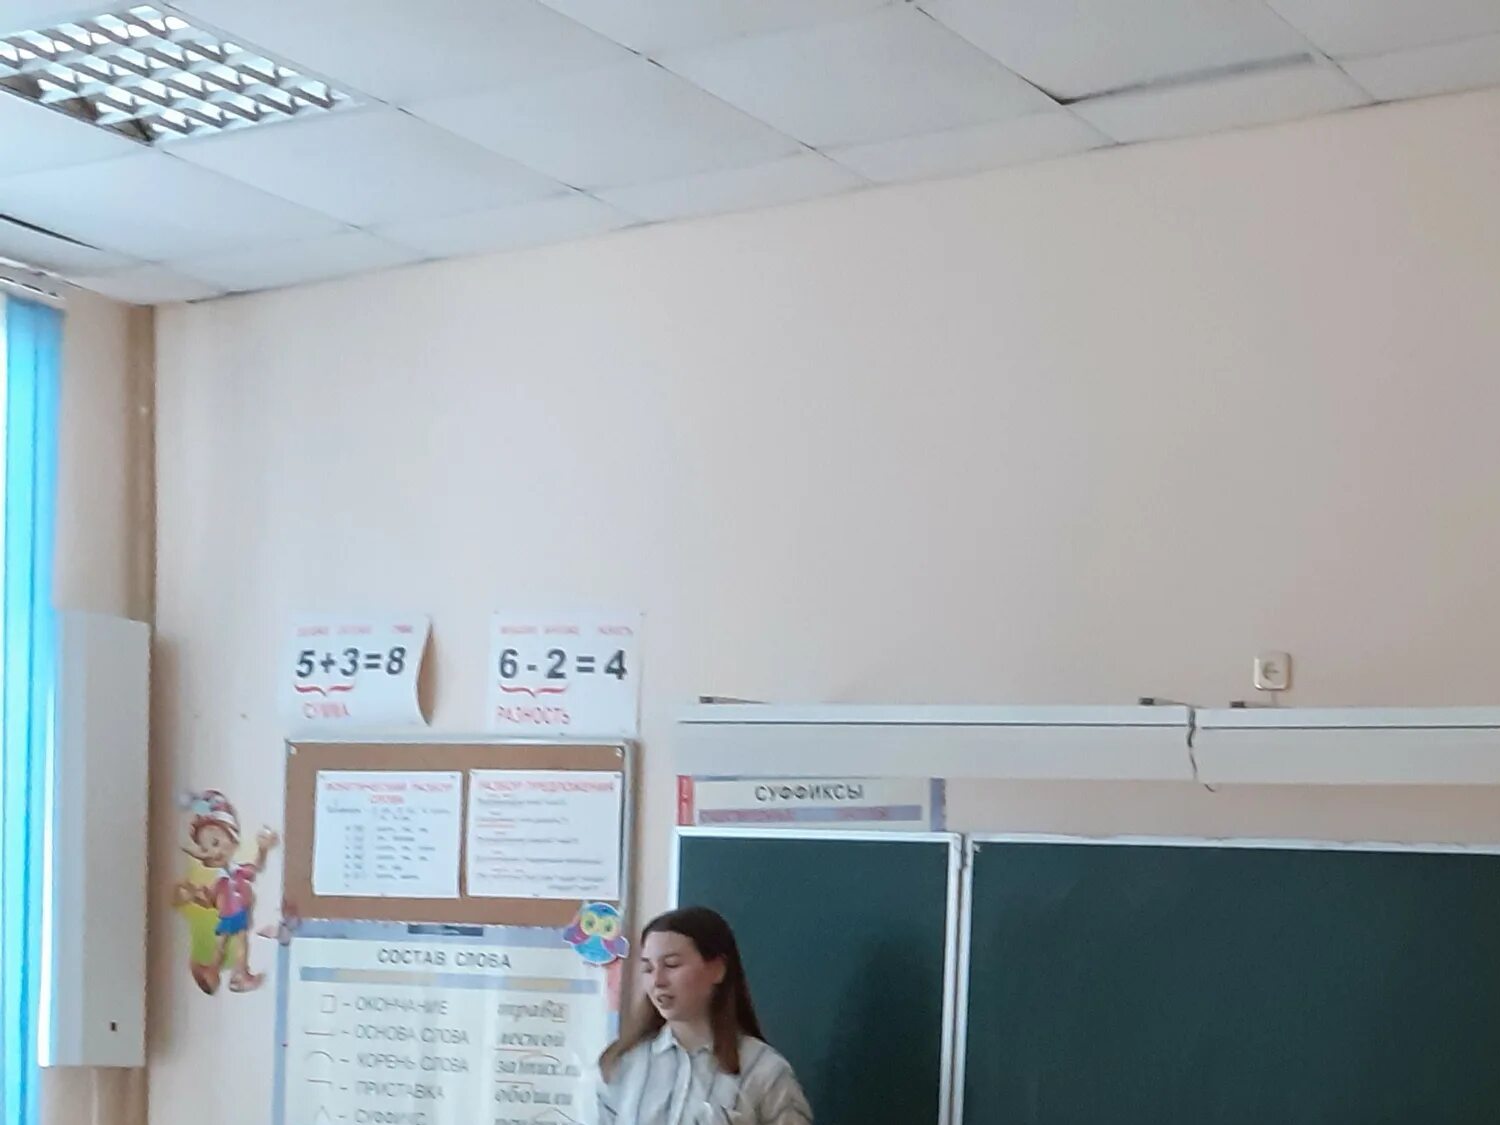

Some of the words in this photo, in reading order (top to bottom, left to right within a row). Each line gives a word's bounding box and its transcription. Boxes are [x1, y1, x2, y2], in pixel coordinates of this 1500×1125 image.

[754, 783, 865, 802] СУФФИКСЫ
[377, 947, 448, 967] СОСТАВ
[455, 951, 513, 970] СЛОВА
